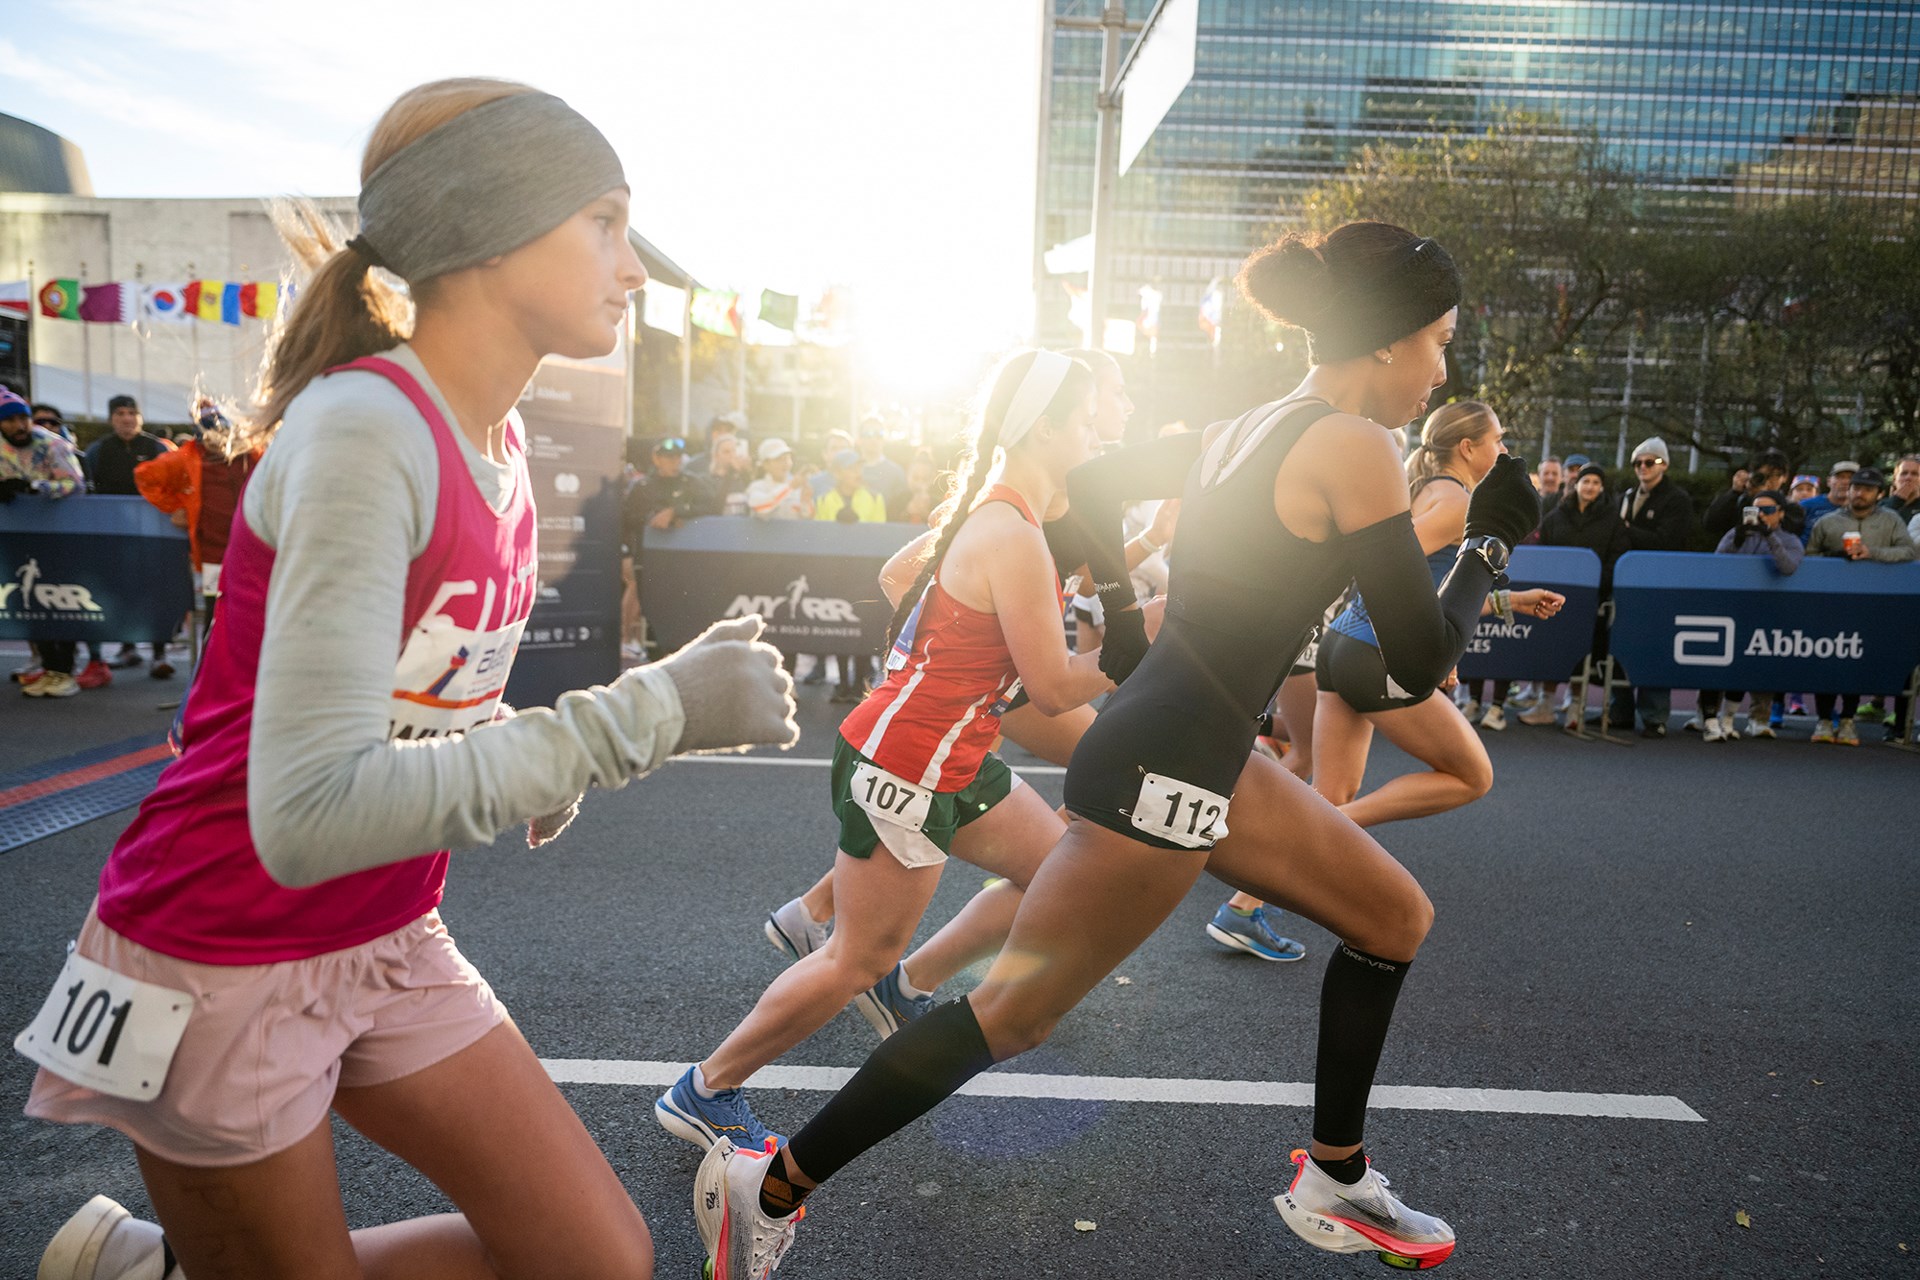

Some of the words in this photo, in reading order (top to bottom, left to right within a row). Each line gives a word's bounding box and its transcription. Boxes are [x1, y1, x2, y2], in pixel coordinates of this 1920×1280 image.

[0, 583, 102, 611] YRR
[724, 595, 860, 622] NYRR
[779, 624, 810, 636] ROAD
[812, 626, 862, 638] RUNNERS
[1475, 622, 1533, 640] LTANCY
[1744, 628, 1864, 660] Abbott
[864, 775, 916, 815] 107
[1163, 791, 1221, 841] 112
[52, 978, 133, 1067] 101
